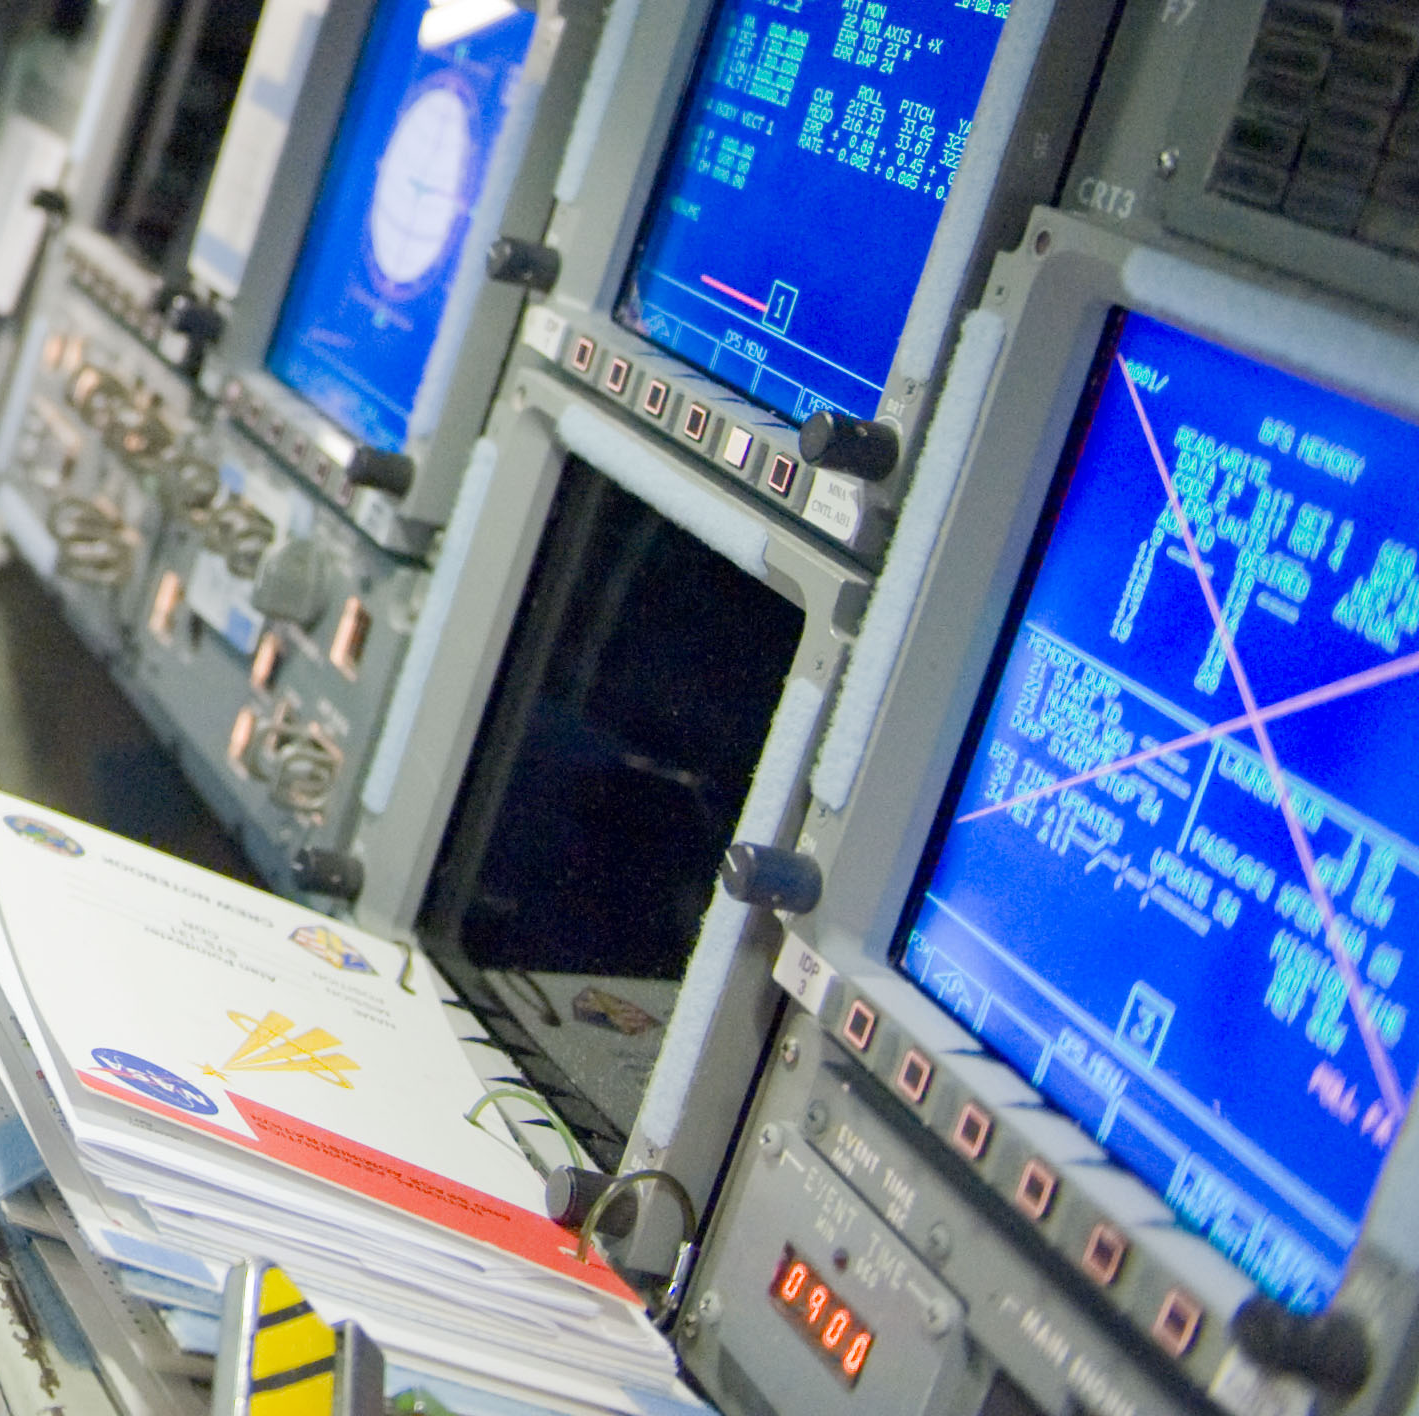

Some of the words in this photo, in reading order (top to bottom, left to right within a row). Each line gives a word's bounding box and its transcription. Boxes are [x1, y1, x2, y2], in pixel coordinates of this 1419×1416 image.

[836, 27, 859, 46] ERR
[860, 35, 882, 53] TOT
[883, 42, 900, 58] 23
[841, 12, 858, 29] 22
[882, 24, 912, 44] AXIS
[913, 33, 924, 49] 1
[925, 37, 943, 55] +X
[831, 43, 854, 62] ERR
[855, 50, 877, 69] DAP
[878, 57, 895, 75] 24
[811, 87, 834, 106] CUR
[845, 99, 886, 124] 215.53
[898, 117, 937, 141] 33.62
[856, 85, 885, 106] ROLL
[898, 99, 936, 124] PITCH
[796, 133, 824, 155] RATE
[840, 115, 881, 139] 216.44
[893, 133, 931, 157] 33.67
[894, 151, 926, 174] 0.45
[1077, 177, 1137, 219] CRT3
[773, 294, 786, 318] 1
[742, 338, 769, 362] MENU
[1174, 425, 1272, 485] READ/WRITE
[1177, 451, 1215, 483] DATA
[1297, 432, 1365, 485] MEMORY
[1029, 631, 1081, 673] MEMORY
[1080, 659, 1121, 696] DUMP
[1052, 664, 1098, 706] START
[1011, 711, 1045, 743] DUMP
[1045, 689, 1100, 734] NUMBER
[989, 741, 1017, 770] BFS
[100, 854, 212, 905] NOTEBOOK
[212, 897, 275, 929] CREW
[798, 951, 820, 976] IDP
[96, 1052, 209, 1108] NASA
[836, 1124, 881, 1173] EVENT
[883, 1165, 919, 1208] TIME
[802, 1166, 858, 1229] EVENT
[867, 1233, 908, 1288] TIME
[780, 1261, 872, 1376] 0900
